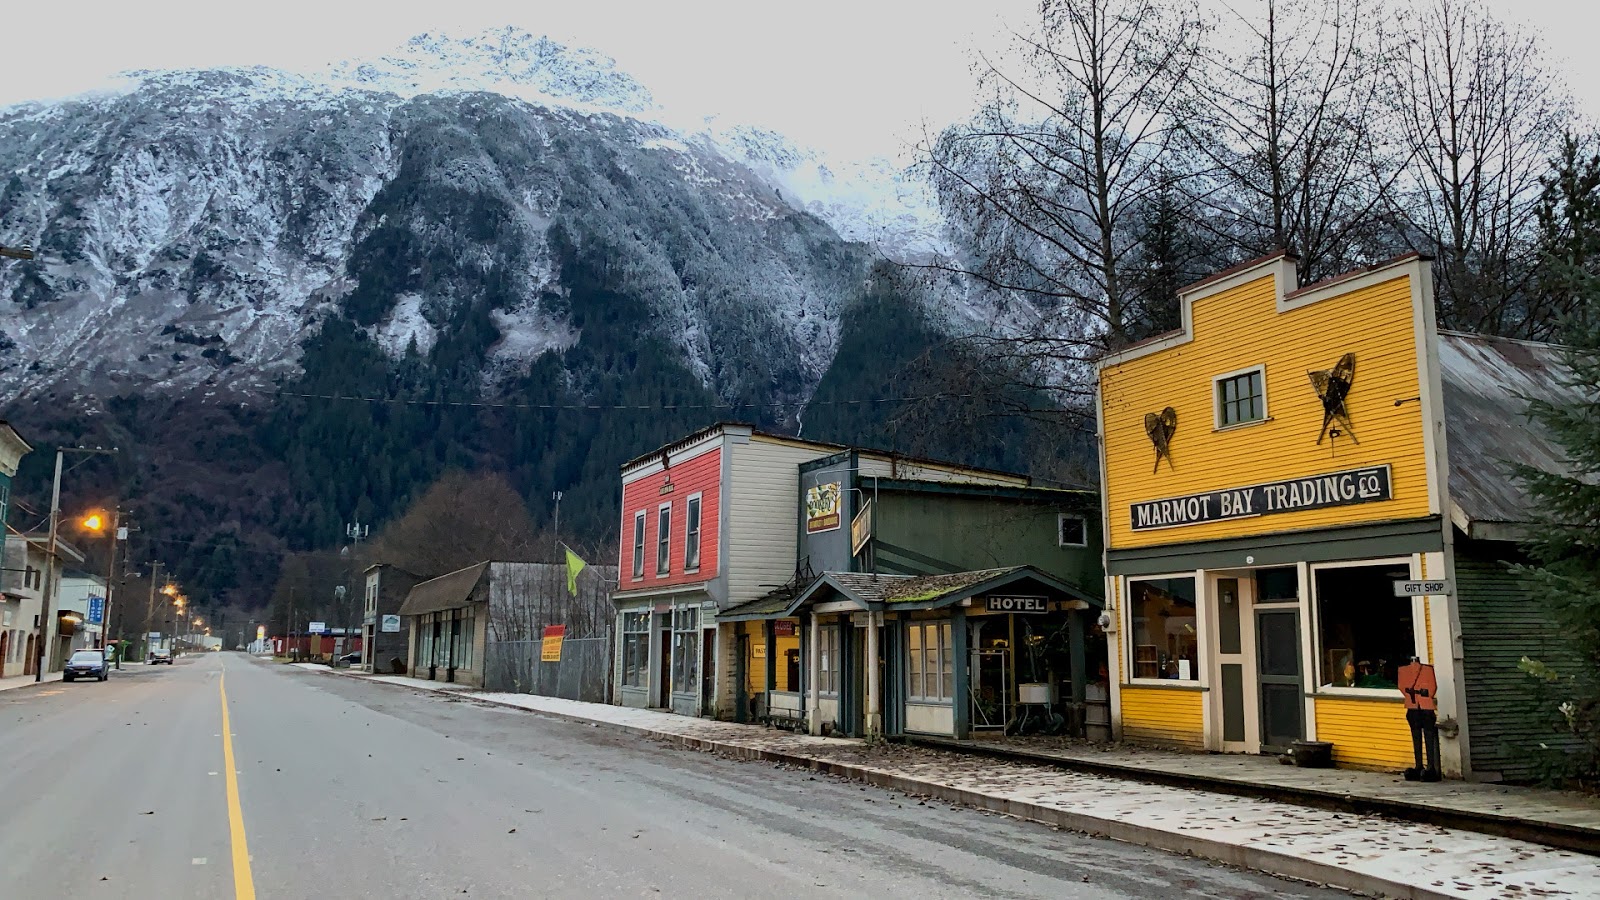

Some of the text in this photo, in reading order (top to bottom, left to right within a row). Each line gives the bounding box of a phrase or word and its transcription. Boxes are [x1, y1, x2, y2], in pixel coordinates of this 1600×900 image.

[1137, 497, 1211, 527] MARMOT
[1220, 489, 1254, 516] BAY
[1264, 474, 1356, 510] TRADING
[1404, 582, 1444, 592] GIFT SHOP
[990, 597, 1045, 610] HOTEL
